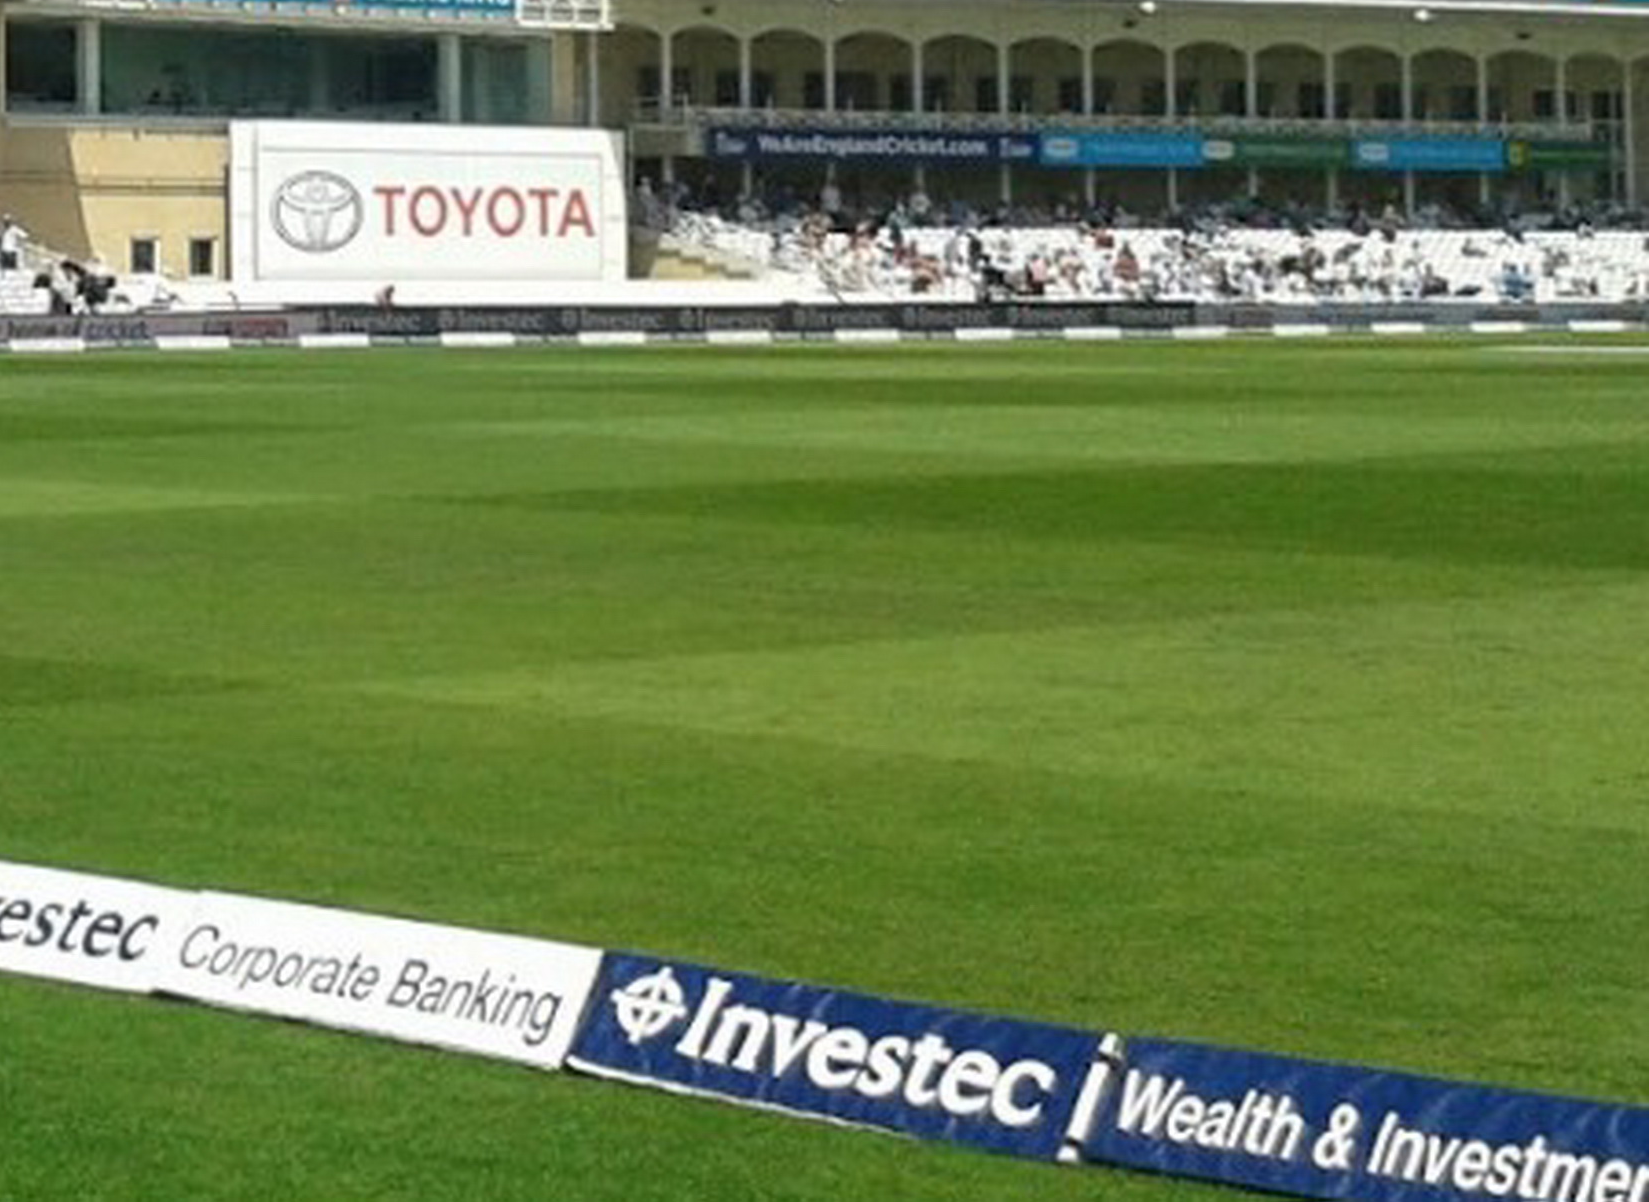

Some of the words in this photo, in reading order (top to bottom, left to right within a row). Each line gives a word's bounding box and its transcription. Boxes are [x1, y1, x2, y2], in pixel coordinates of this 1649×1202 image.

[372, 185, 596, 239] TOYOTA
[178, 923, 382, 1003] Corporate
[385, 959, 564, 1046] Banking
[674, 976, 1058, 1127] Investec
[1116, 1068, 1307, 1161] Wealth
[1311, 1102, 1363, 1169] &
